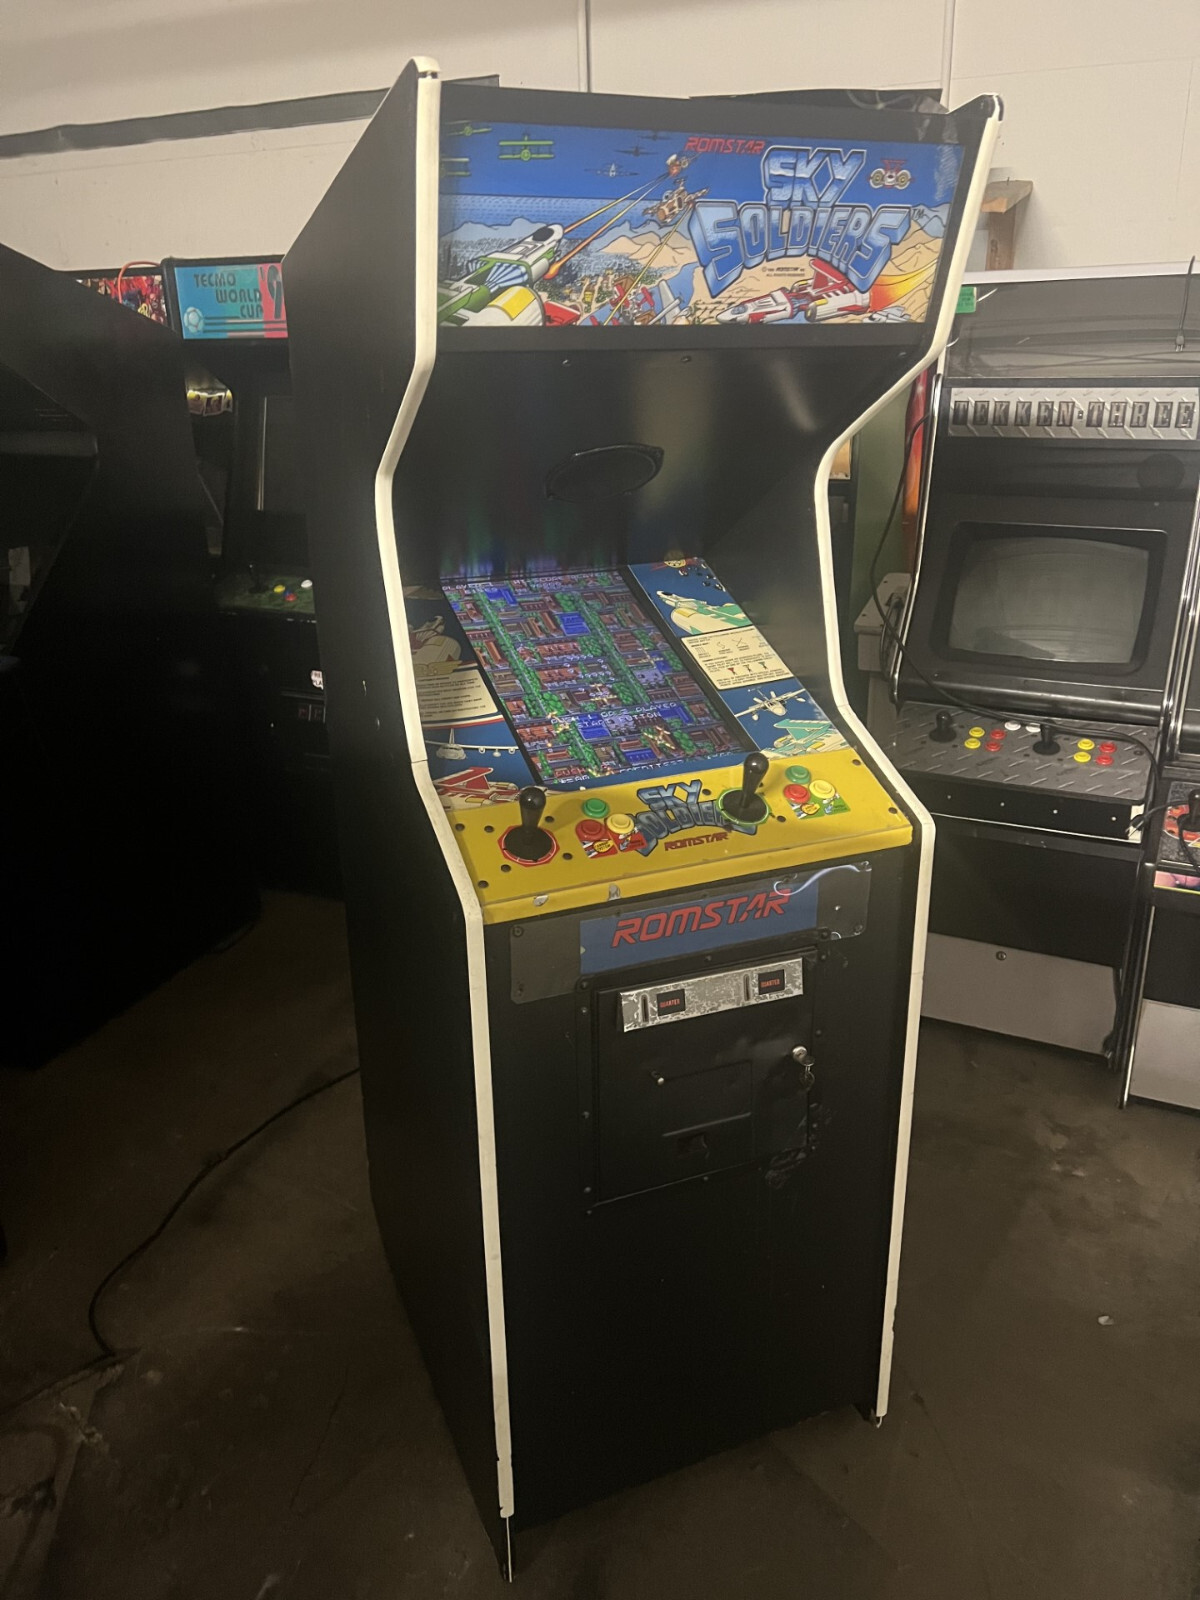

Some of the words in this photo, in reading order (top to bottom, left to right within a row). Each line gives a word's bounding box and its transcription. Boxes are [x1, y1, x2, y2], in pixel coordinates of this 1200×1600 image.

[685, 136, 765, 155] ROMSTAR
[762, 145, 867, 206] SKY
[688, 199, 911, 299] SOLDIERS
[194, 273, 237, 288] TECMO
[215, 289, 263, 304] WORLD
[240, 304, 263, 319] CUP
[637, 779, 702, 812] SKY
[626, 799, 758, 857] OLDIE
[664, 832, 730, 851] ROMSTAR
[610, 888, 792, 948] ROMSTAR
